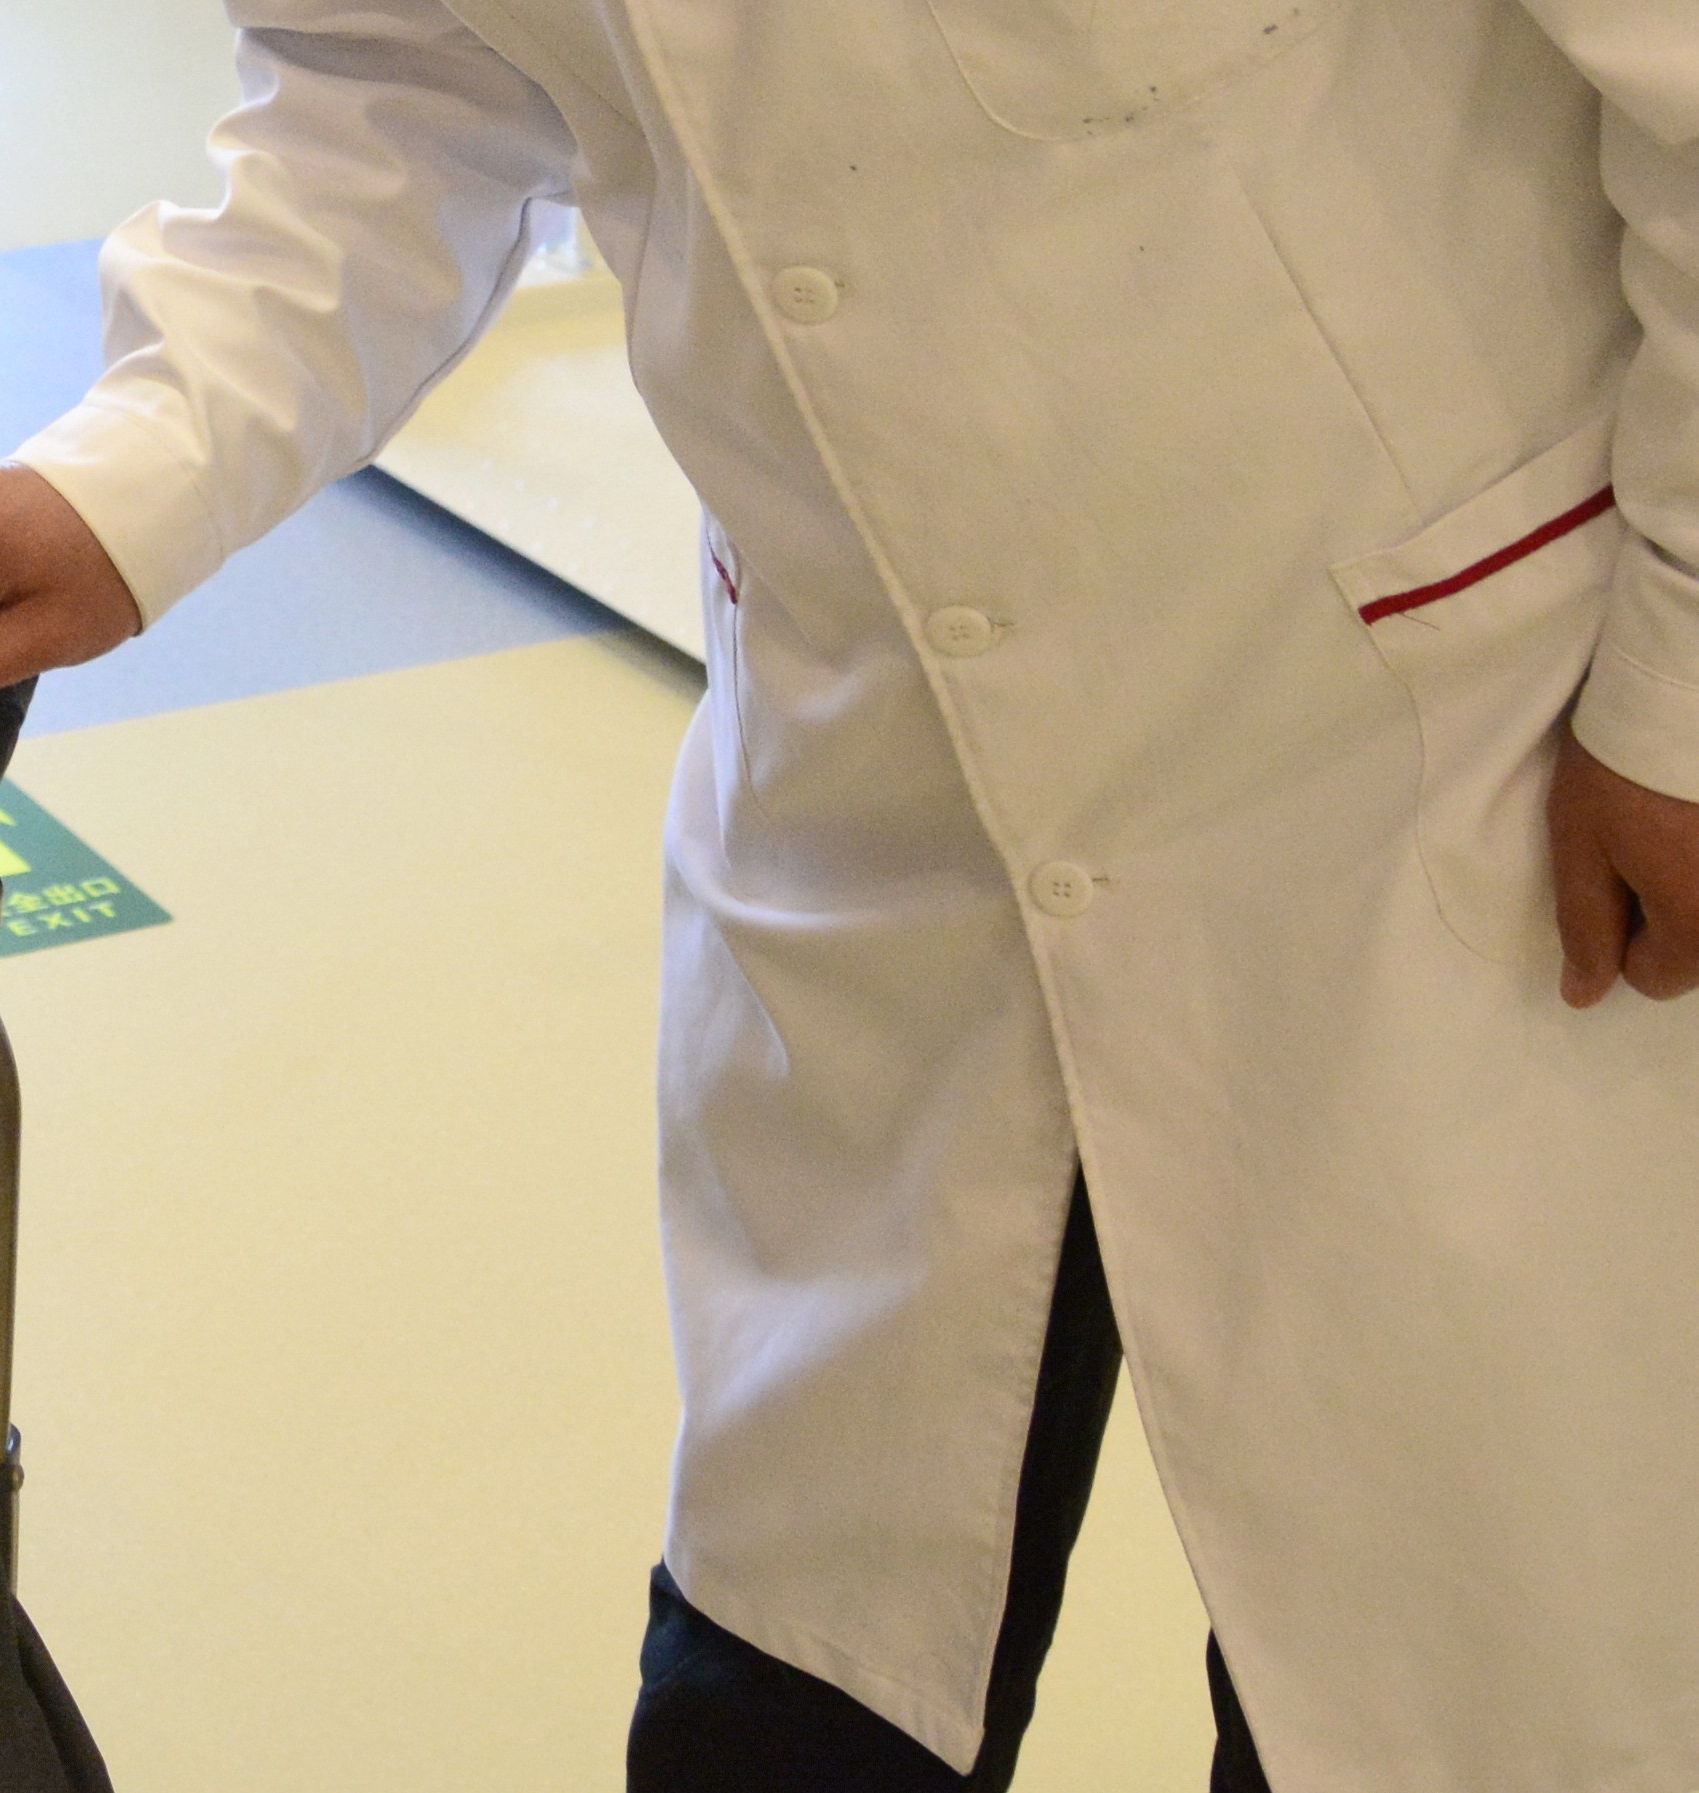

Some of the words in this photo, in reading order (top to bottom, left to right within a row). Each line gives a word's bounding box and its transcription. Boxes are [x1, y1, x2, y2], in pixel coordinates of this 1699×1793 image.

[2, 876, 120, 917] 全出口
[8, 901, 116, 937] EXIT
